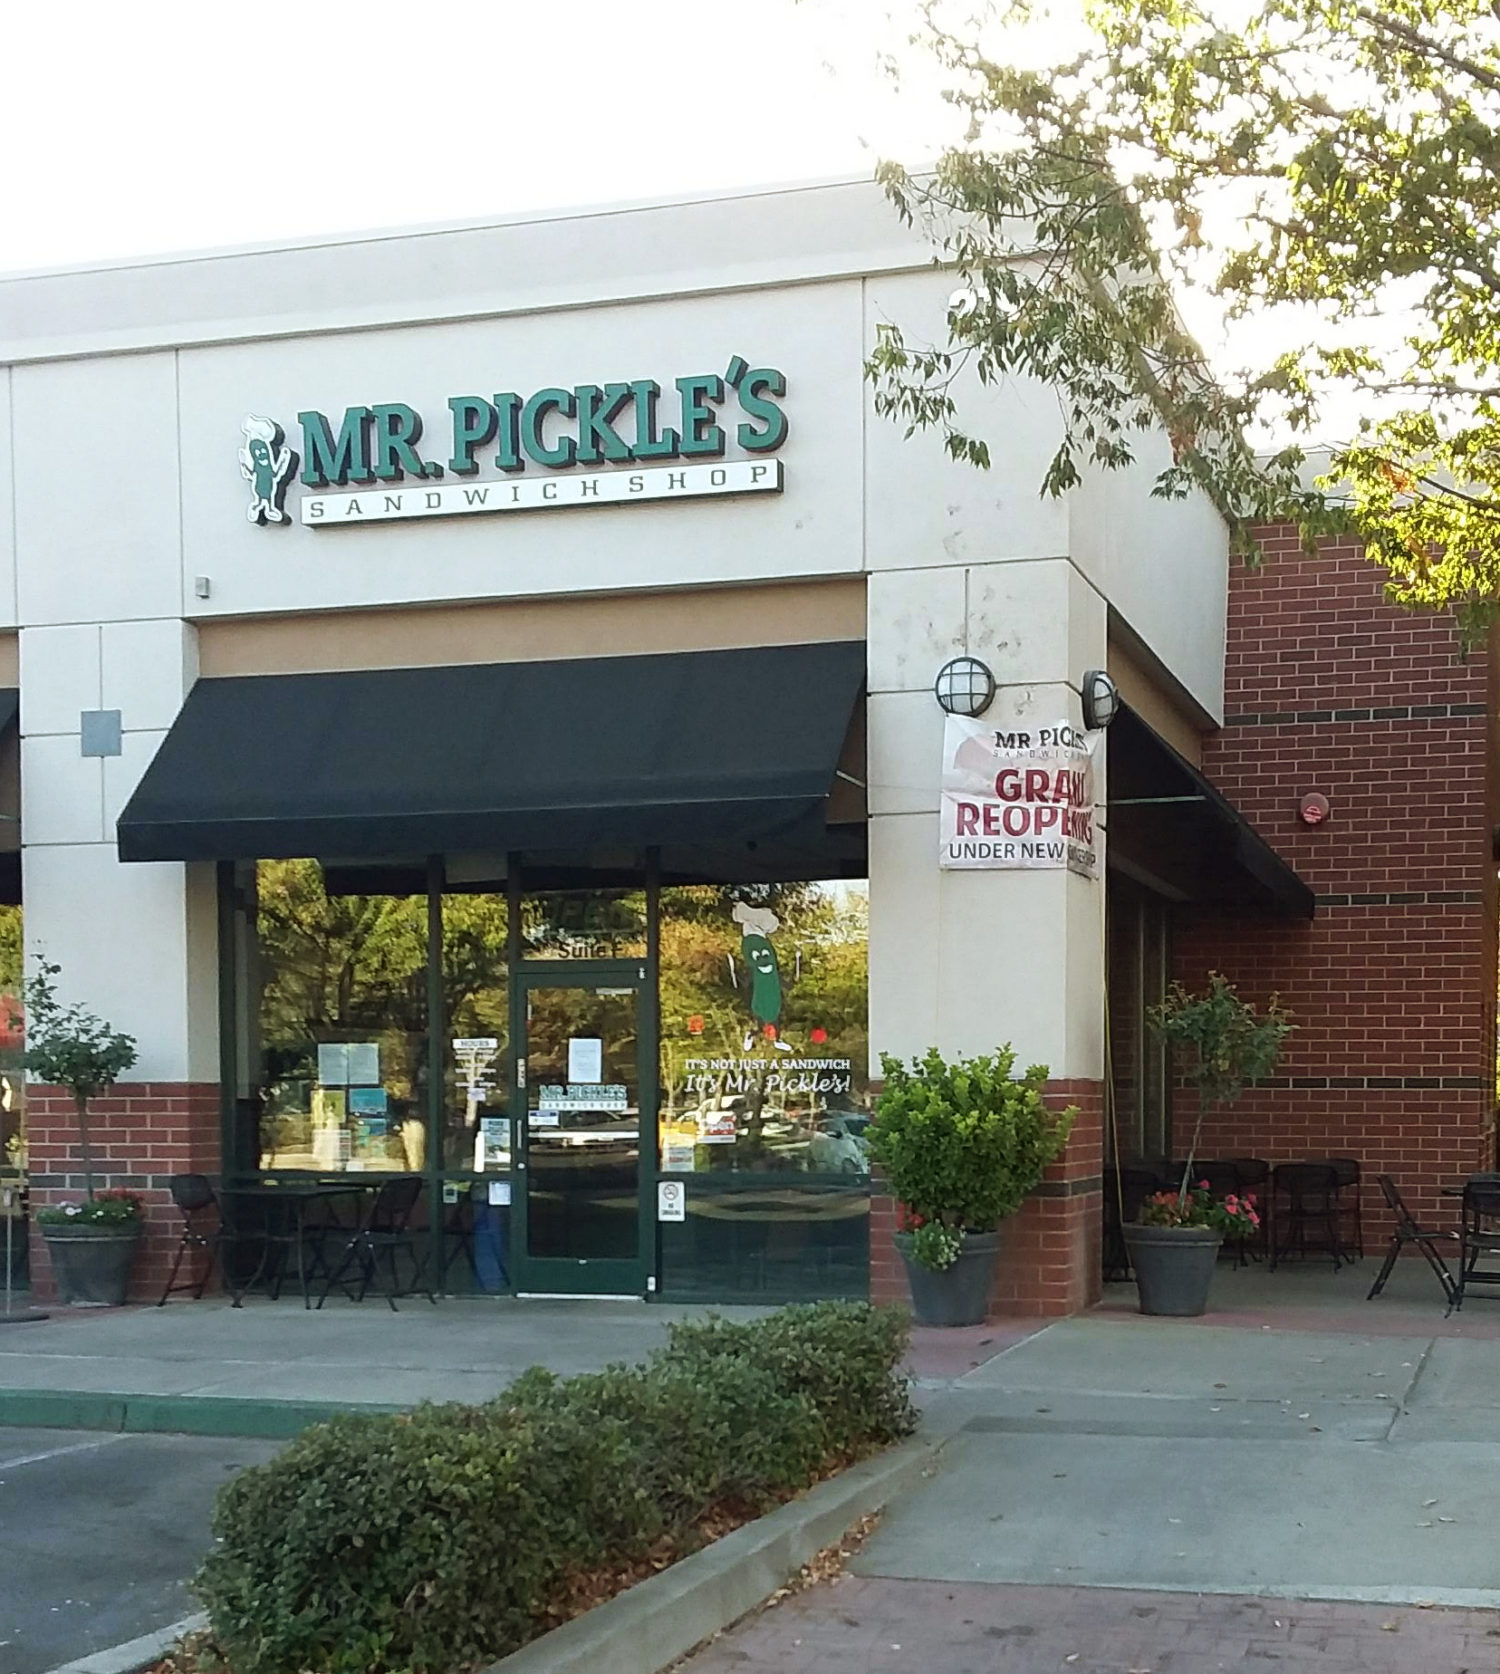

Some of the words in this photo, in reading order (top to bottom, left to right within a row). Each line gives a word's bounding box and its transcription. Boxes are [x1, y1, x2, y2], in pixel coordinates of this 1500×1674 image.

[297, 402, 444, 487] MR.
[447, 353, 789, 475] PICKLE'S
[309, 479, 600, 518] SANDWICH
[628, 465, 769, 494] SHOP
[995, 731, 1031, 749] MR
[950, 843, 1015, 859] UNDER
[1021, 843, 1065, 859] NEW
[558, 940, 607, 958] Suite
[685, 1059, 708, 1070] IT'S
[710, 1059, 736, 1070] NOT
[738, 1059, 767, 1070] JUST
[769, 1059, 780, 1070] A
[781, 1059, 851, 1070] SANDWICH
[684, 1074, 718, 1093] It's
[725, 1073, 758, 1093] Mr.
[764, 1072, 851, 1096] Pickle's!
